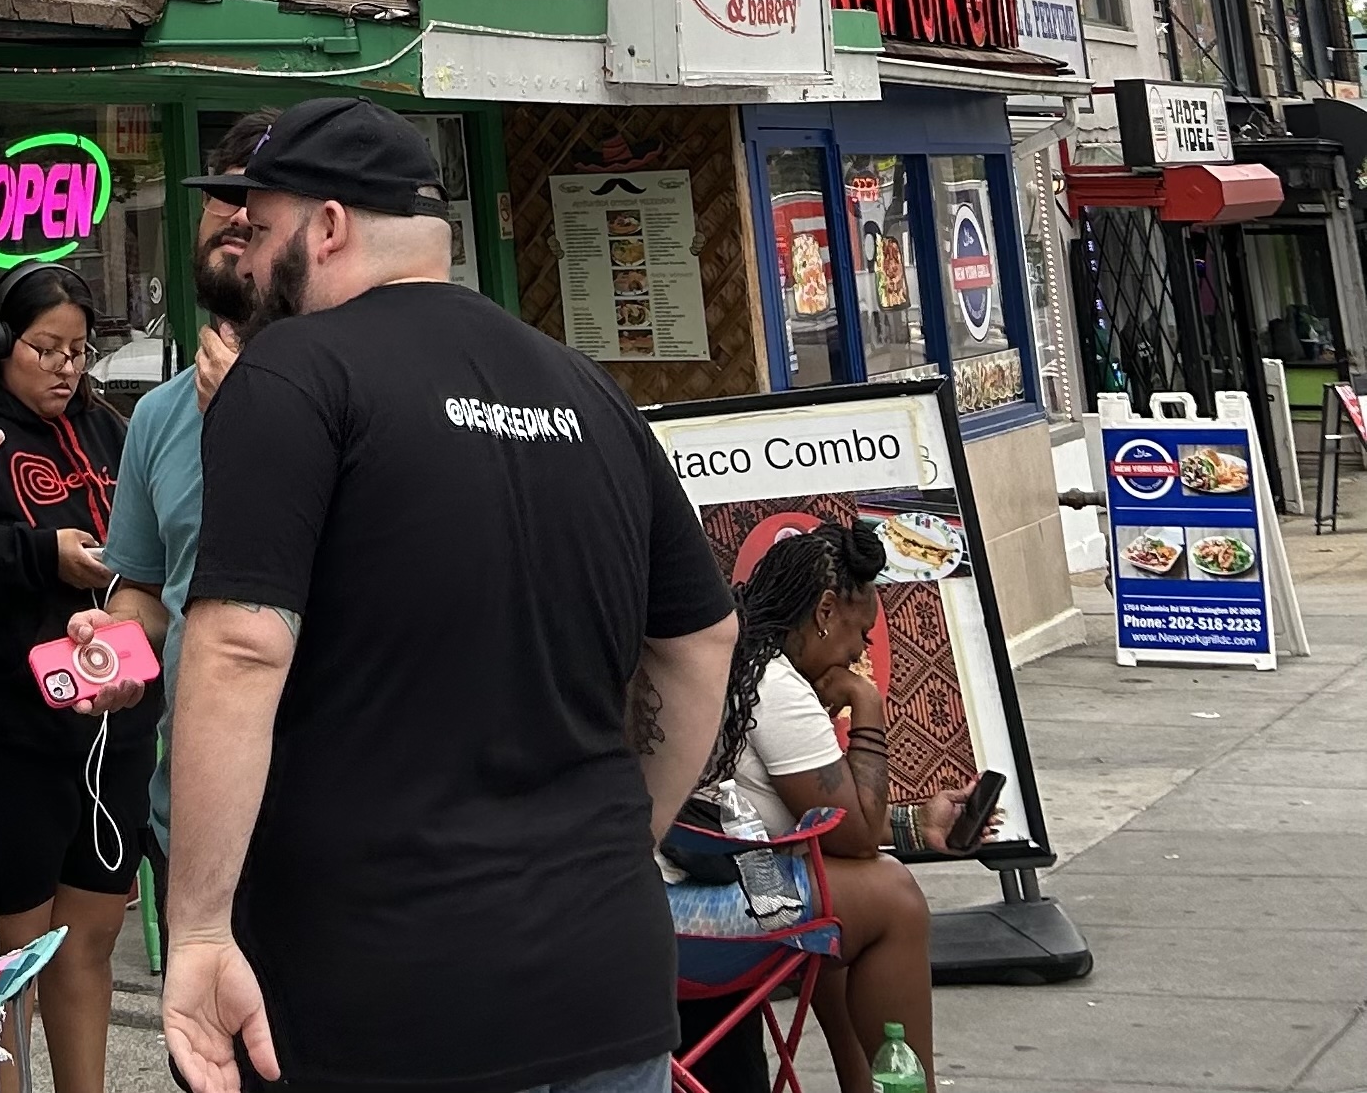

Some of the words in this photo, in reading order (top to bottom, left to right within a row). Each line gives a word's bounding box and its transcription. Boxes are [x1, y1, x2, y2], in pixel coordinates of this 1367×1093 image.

[672, 447, 753, 480] taco
[764, 429, 903, 471] Combo
[1114, 464, 1131, 473] NEW
[1132, 464, 1152, 473] YORK
[1153, 464, 1175, 474] GRILL
[1123, 615, 1166, 629] Phone:
[1168, 616, 1261, 632] 202-518-2233
